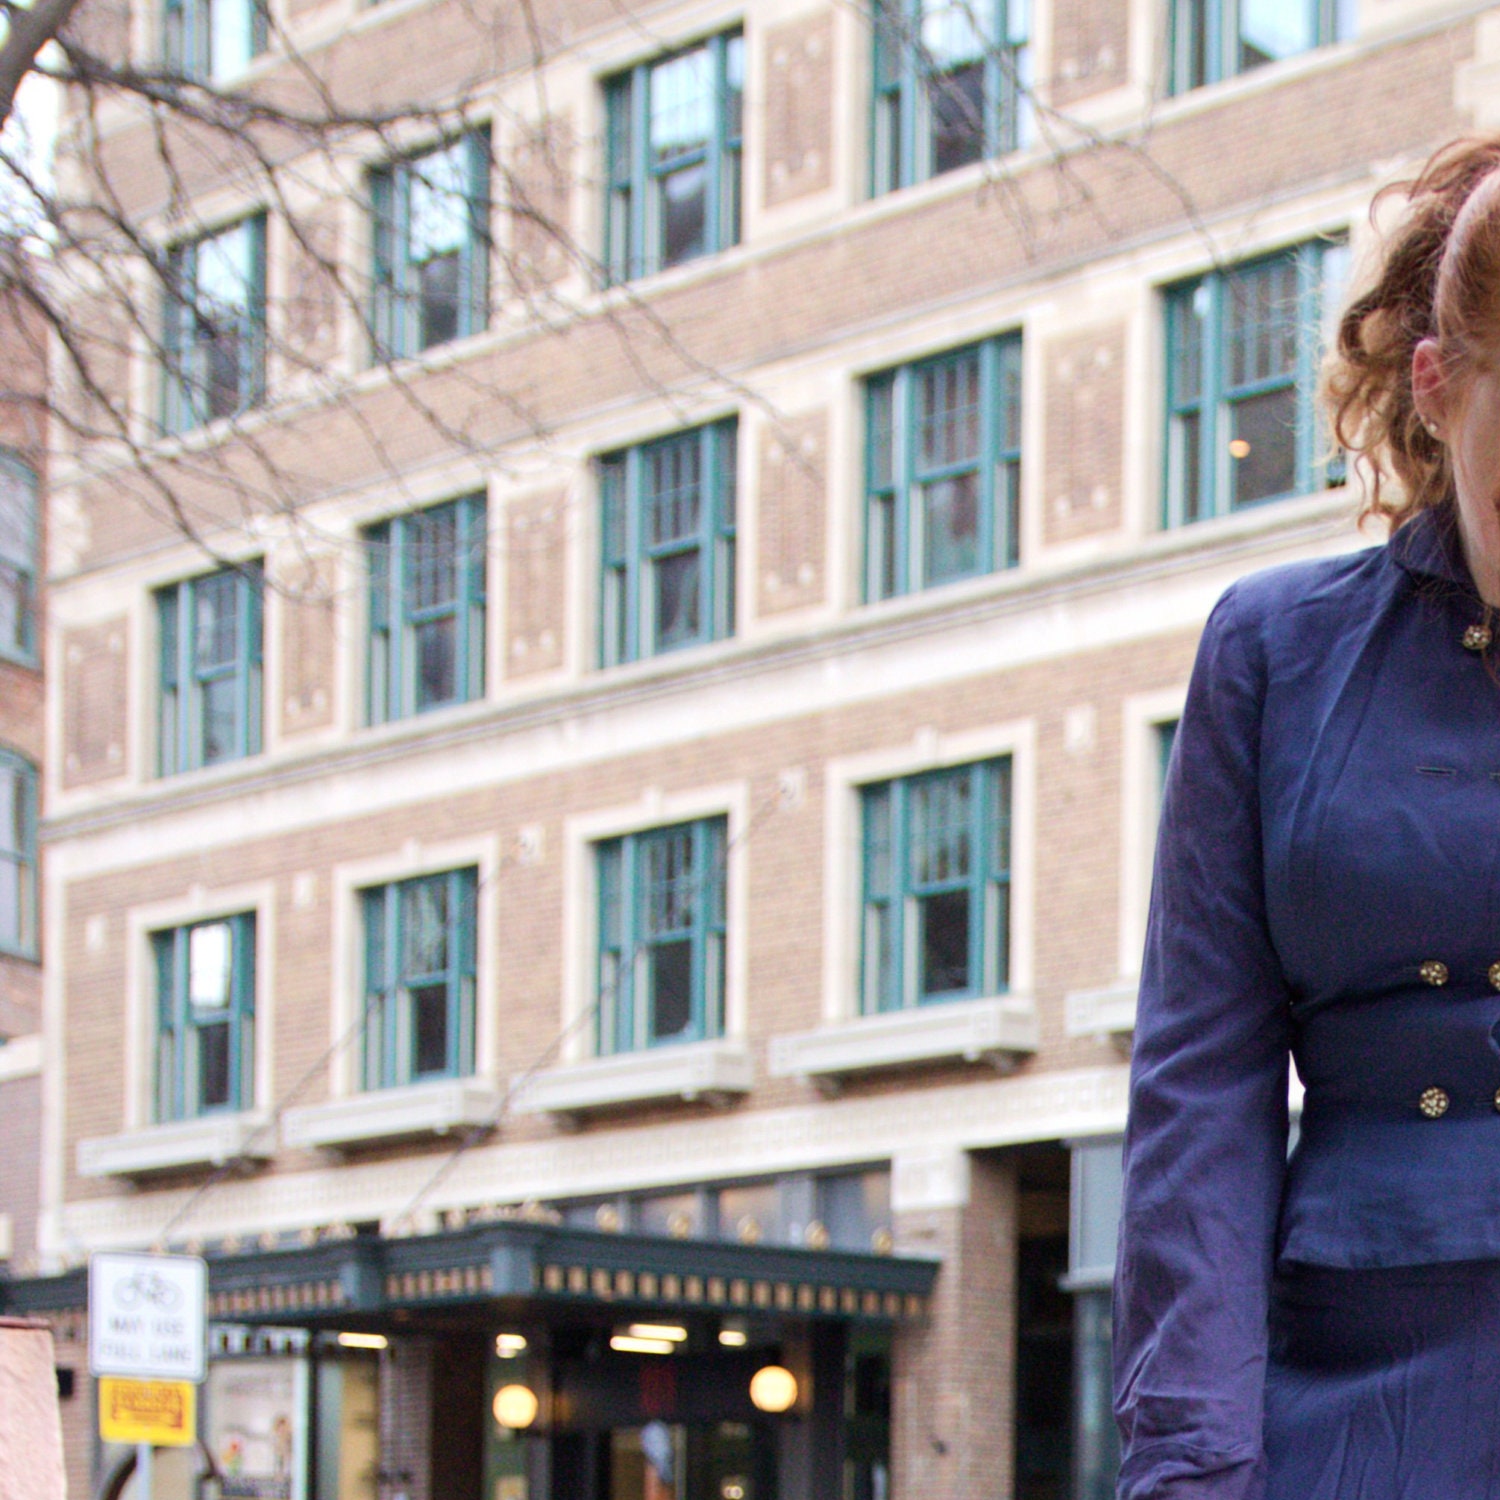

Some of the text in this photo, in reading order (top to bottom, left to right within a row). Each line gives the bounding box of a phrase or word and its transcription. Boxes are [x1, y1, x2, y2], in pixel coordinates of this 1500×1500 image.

[108, 1315, 185, 1337] MAY USE
[149, 1341, 192, 1363] LANE
